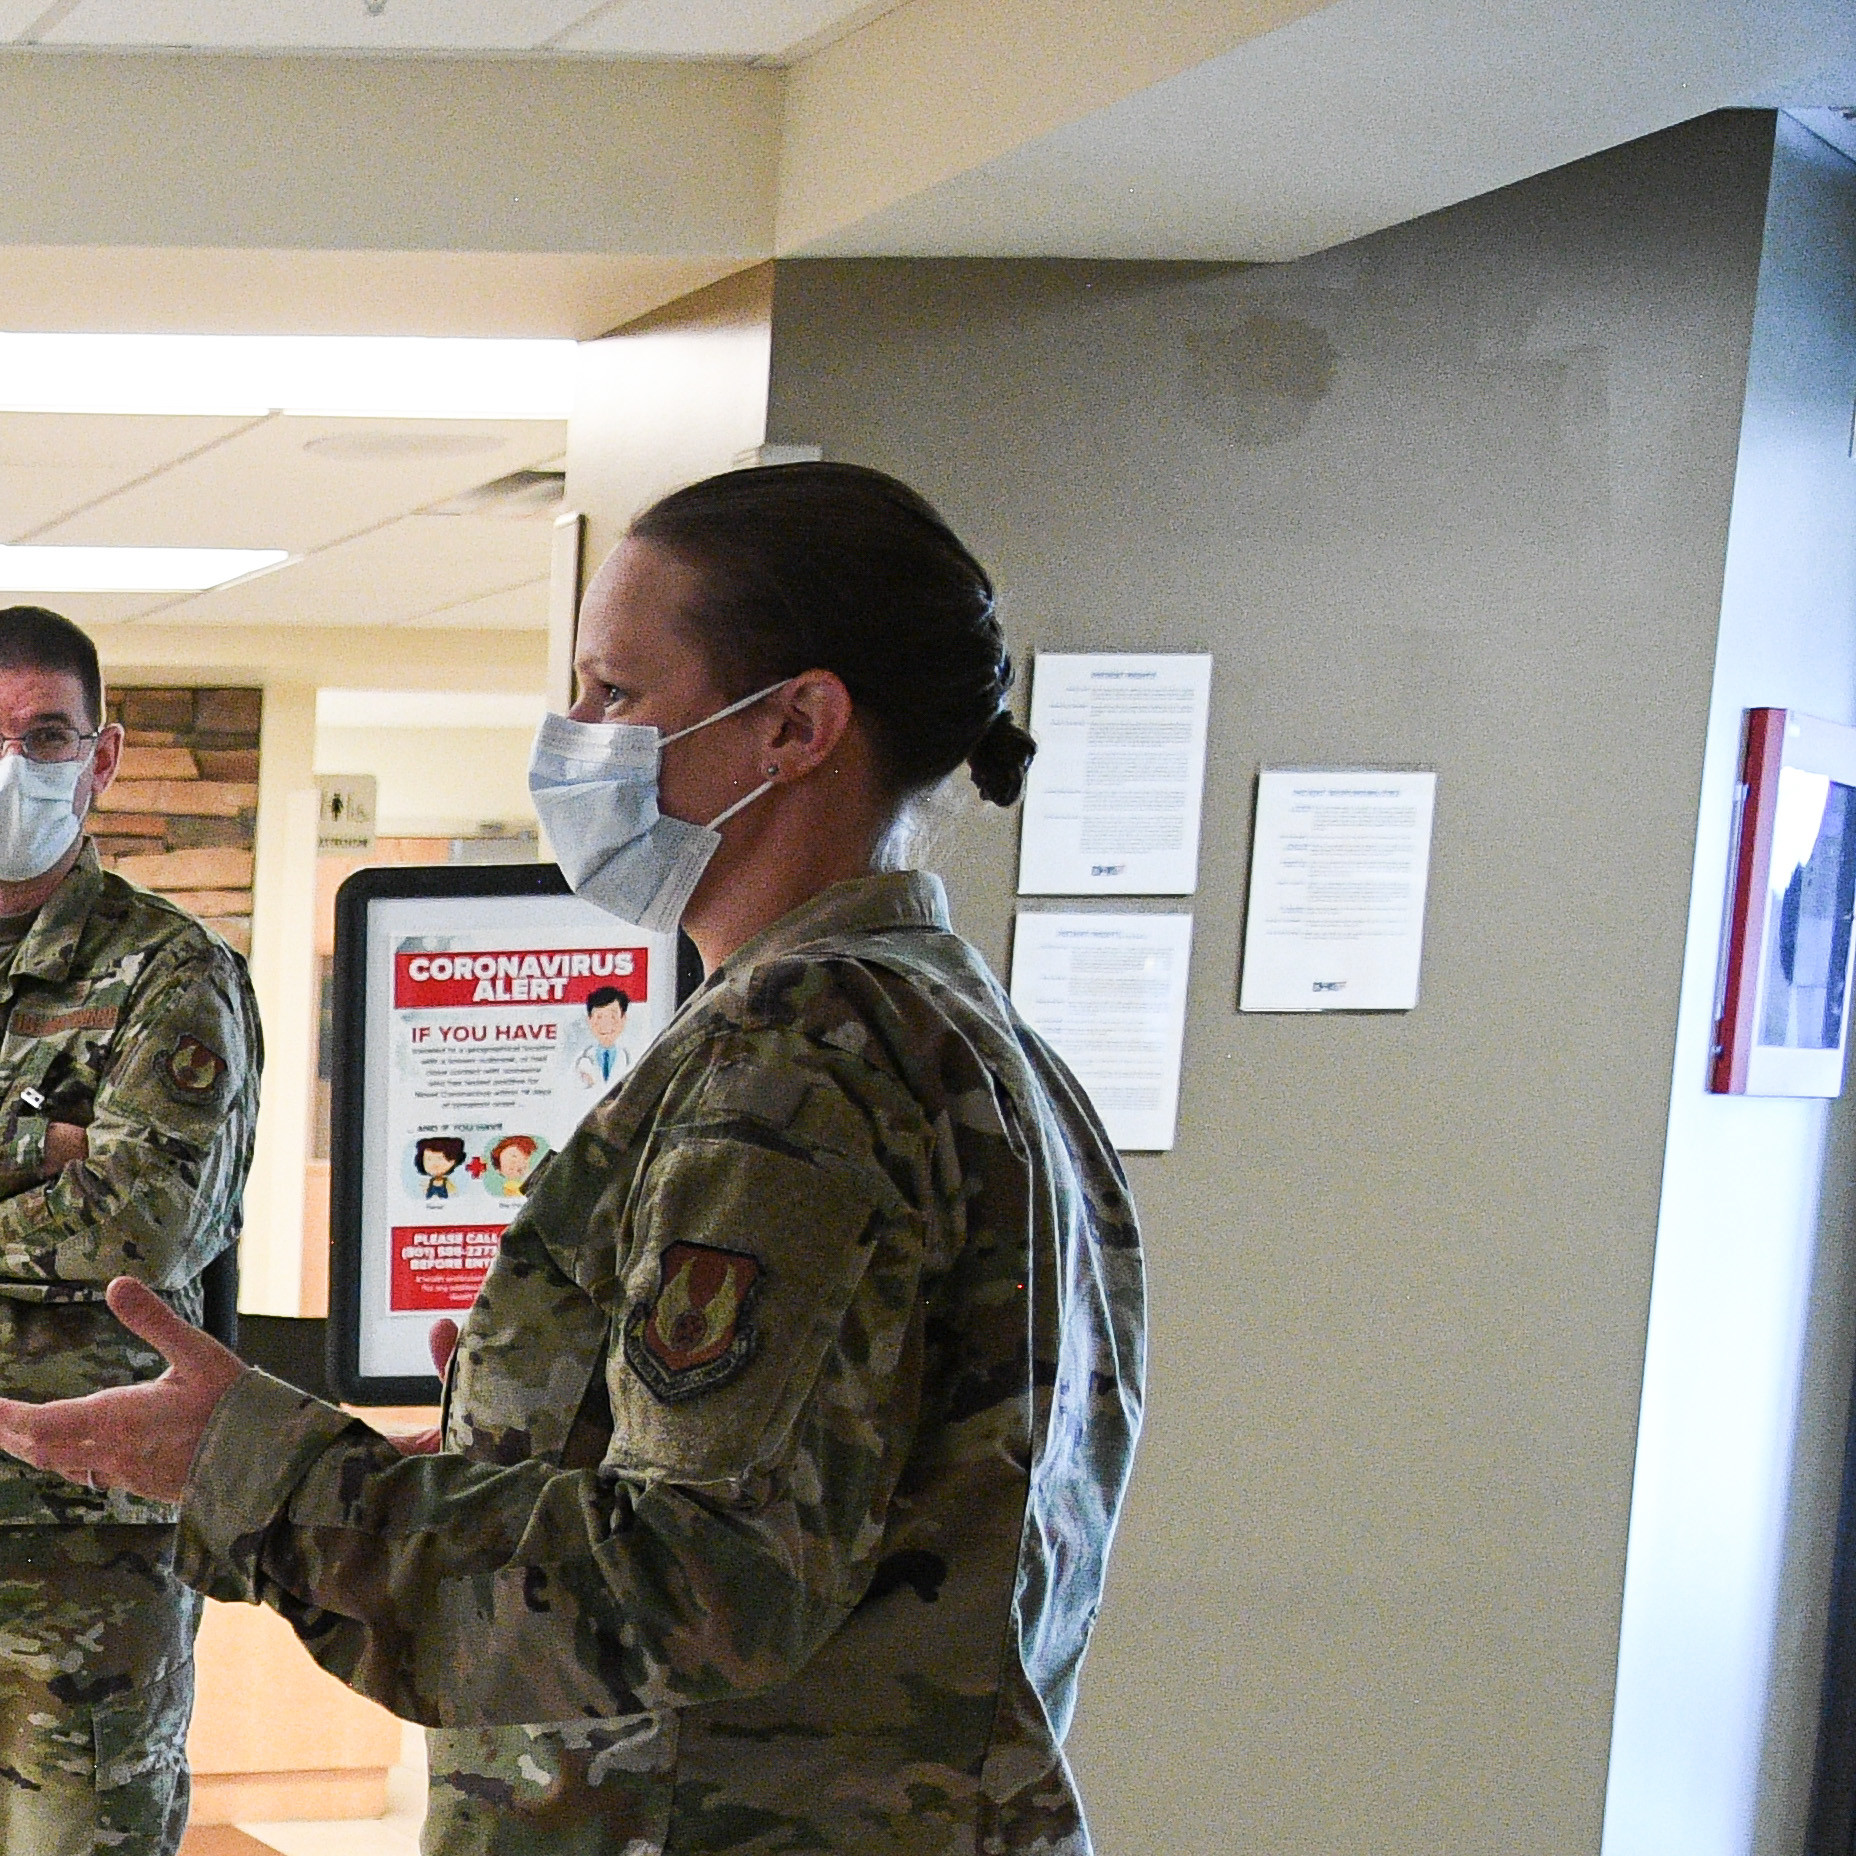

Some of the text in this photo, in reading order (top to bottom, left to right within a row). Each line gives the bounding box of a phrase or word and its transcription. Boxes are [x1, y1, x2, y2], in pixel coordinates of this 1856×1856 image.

[408, 953, 634, 982] CORONAVIRUS
[472, 977, 568, 1002] ALERT
[411, 1024, 558, 1043] IF YOU HAVE
[414, 1233, 463, 1245] PLEASE
